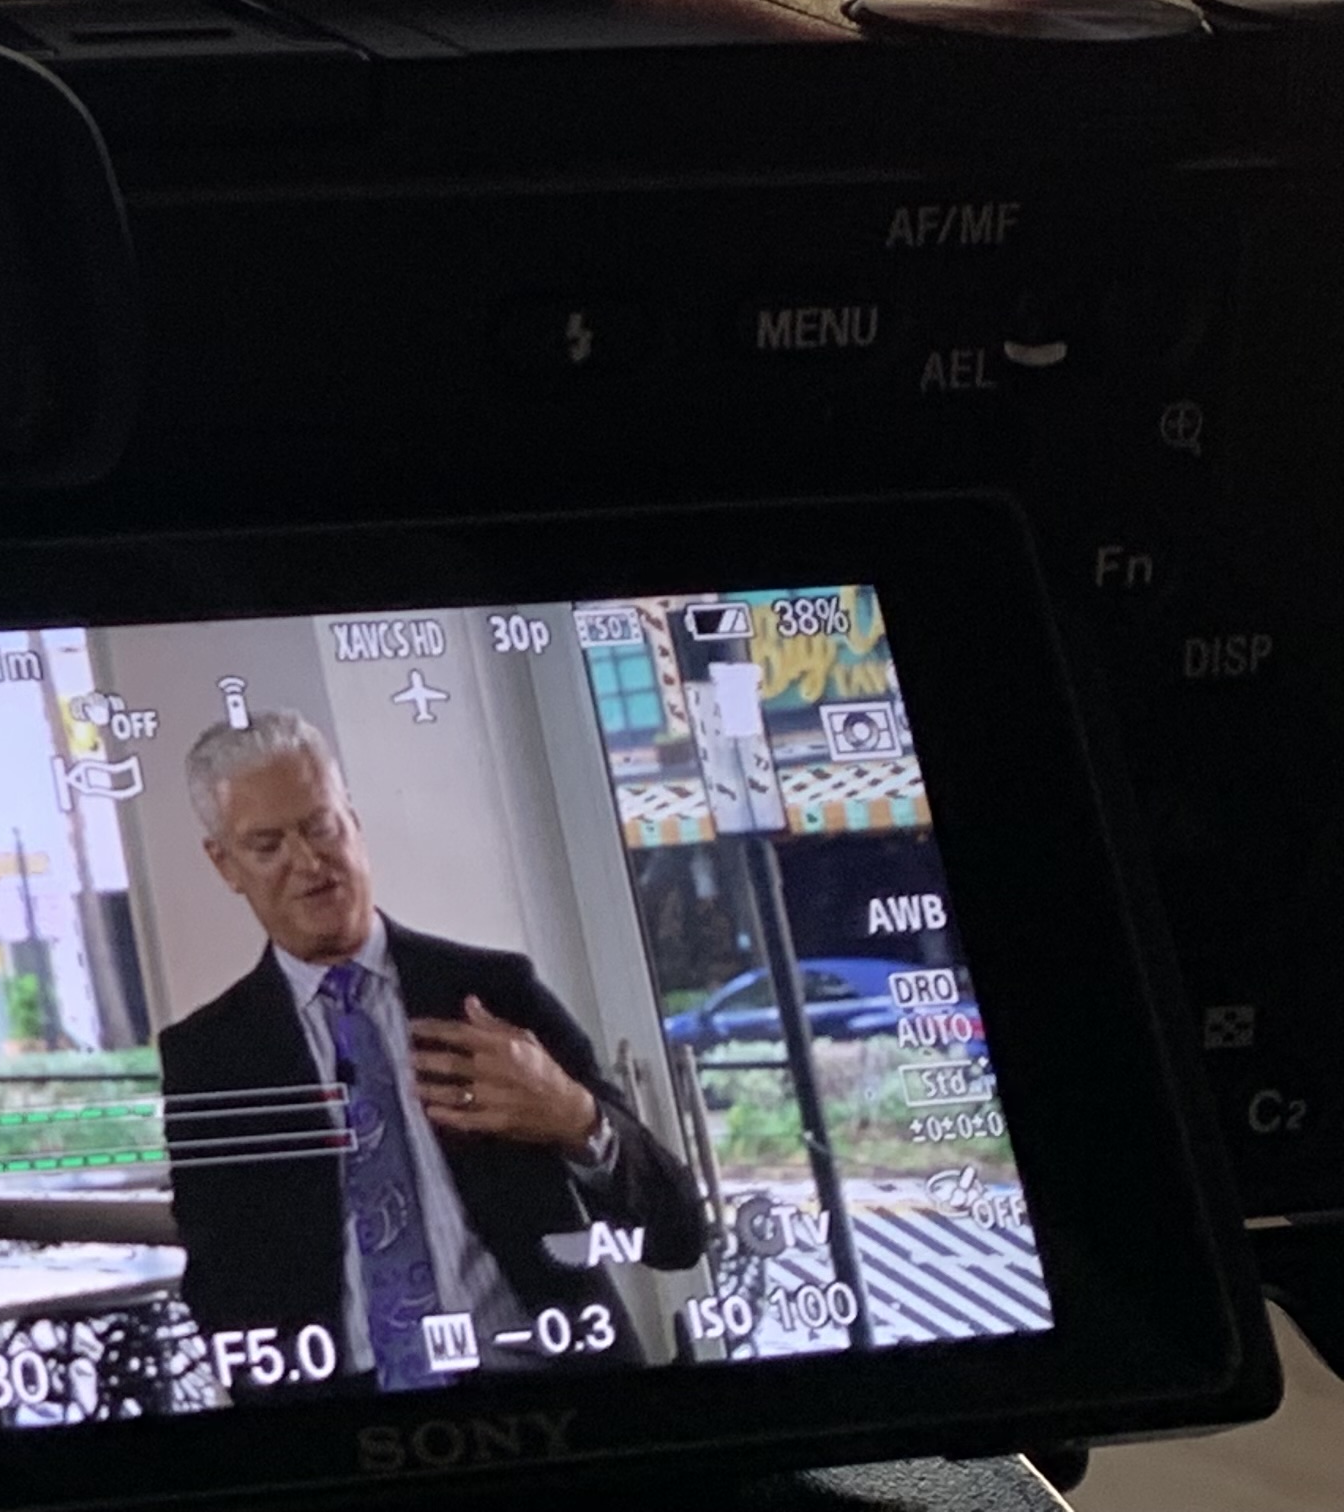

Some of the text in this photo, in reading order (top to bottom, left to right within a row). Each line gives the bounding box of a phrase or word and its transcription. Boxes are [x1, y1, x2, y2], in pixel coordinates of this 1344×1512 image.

[887, 202, 1021, 248] AF/MF
[756, 308, 878, 350] MENU
[920, 350, 997, 392] AEL
[1094, 545, 1154, 588] Fn
[489, 615, 551, 654] 30p
[774, 596, 850, 636] 38%
[1184, 634, 1274, 679] DISP
[111, 711, 159, 740] OFF
[867, 896, 948, 935] AWB
[894, 973, 953, 1004] DRO
[898, 1013, 973, 1048] AUTO
[770, 1207, 831, 1248] Tv
[973, 1196, 1026, 1229] OFF
[588, 1222, 645, 1267] Av
[493, 1303, 616, 1354] -0.3
[687, 1282, 859, 1339] ISO 100
[213, 1325, 337, 1387] F5.0
[358, 1408, 578, 1476] SONY
